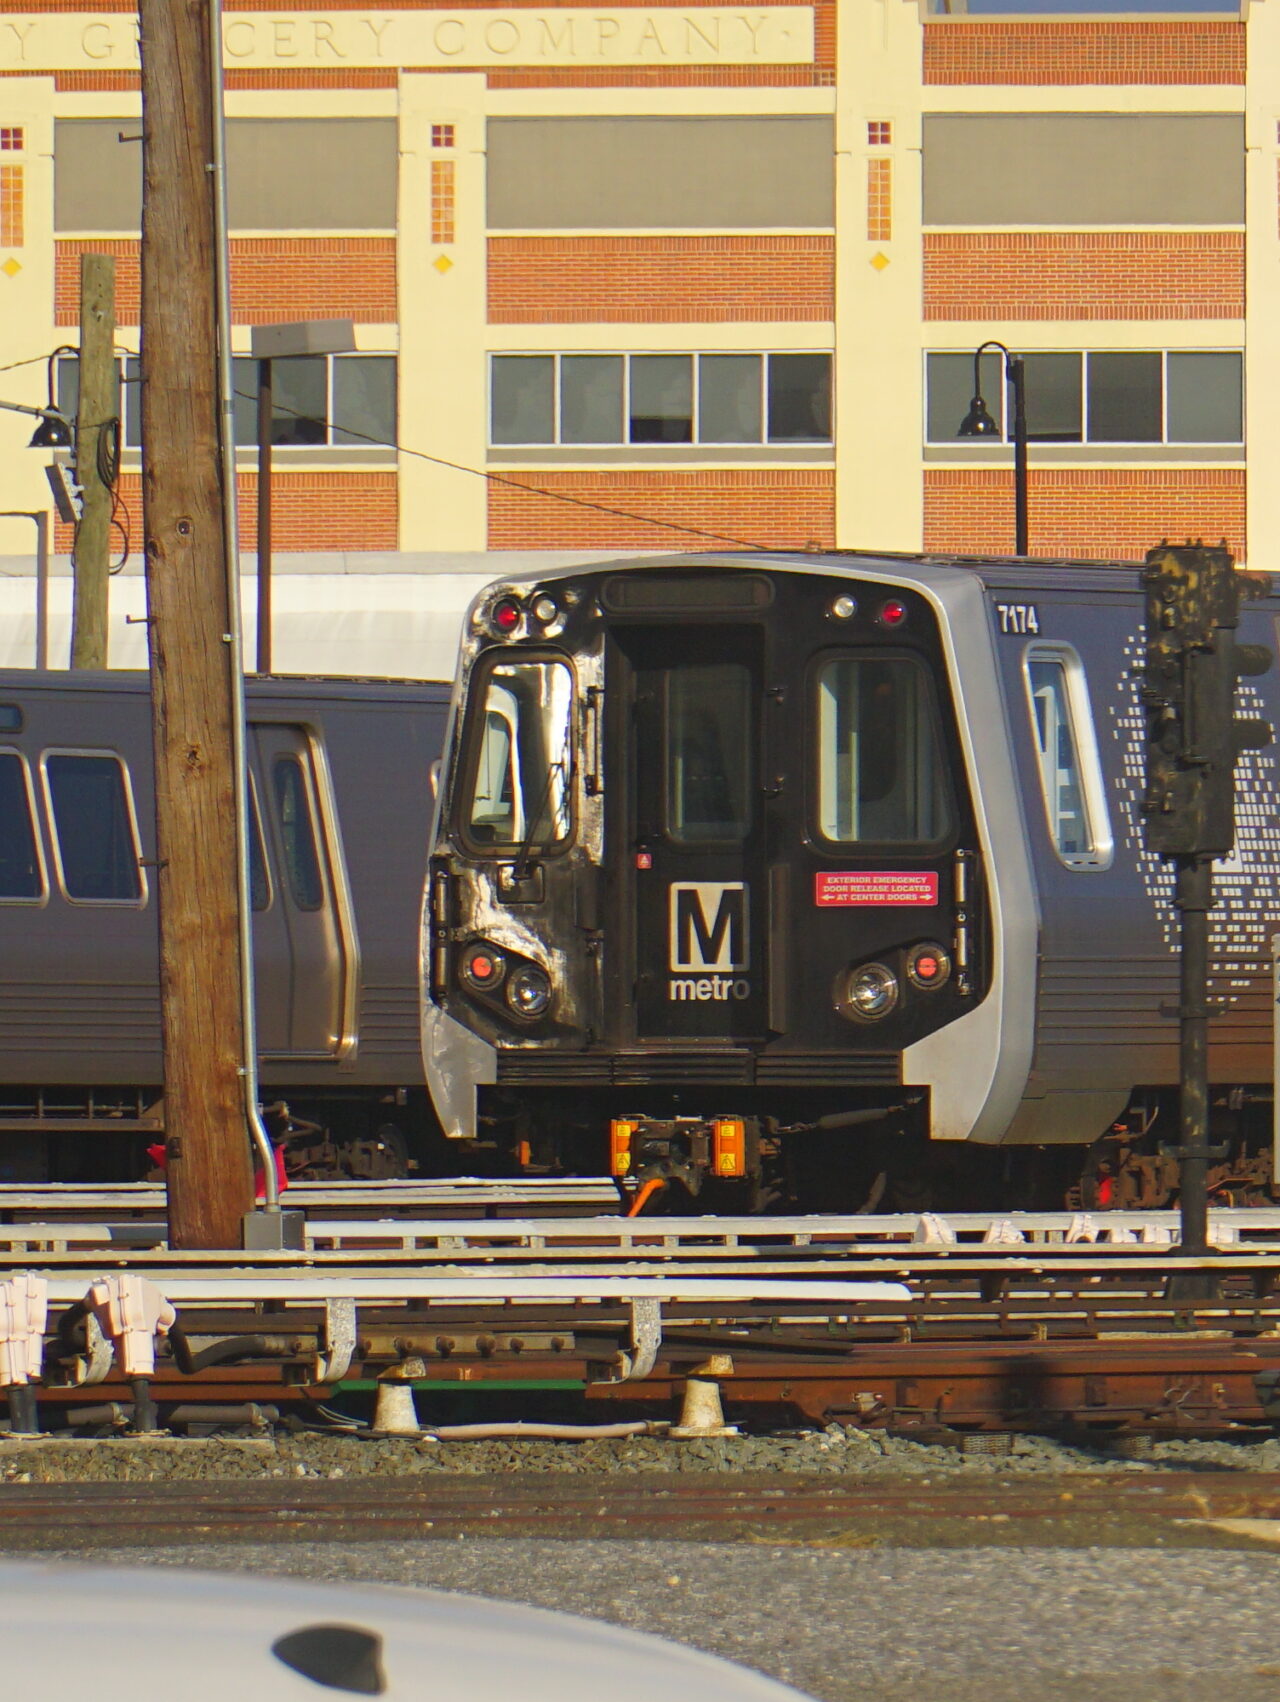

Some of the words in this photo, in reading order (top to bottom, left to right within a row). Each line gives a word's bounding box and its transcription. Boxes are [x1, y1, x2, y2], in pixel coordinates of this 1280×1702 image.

[80, 19, 394, 60] GCERY
[433, 15, 769, 57] COMPANY
[997, 604, 1039, 634] 7174
[823, 885, 849, 893] DOOR
[850, 885, 889, 893] RELEASE
[891, 885, 931, 893] LOCATED
[827, 876, 872, 884] EXTERIOR
[873, 876, 927, 884] EMERGENCY
[837, 893, 848, 901] AT
[850, 893, 886, 901] CENTER
[888, 893, 918, 901] DOORS
[677, 888, 746, 966] M
[670, 974, 750, 1001] metro
